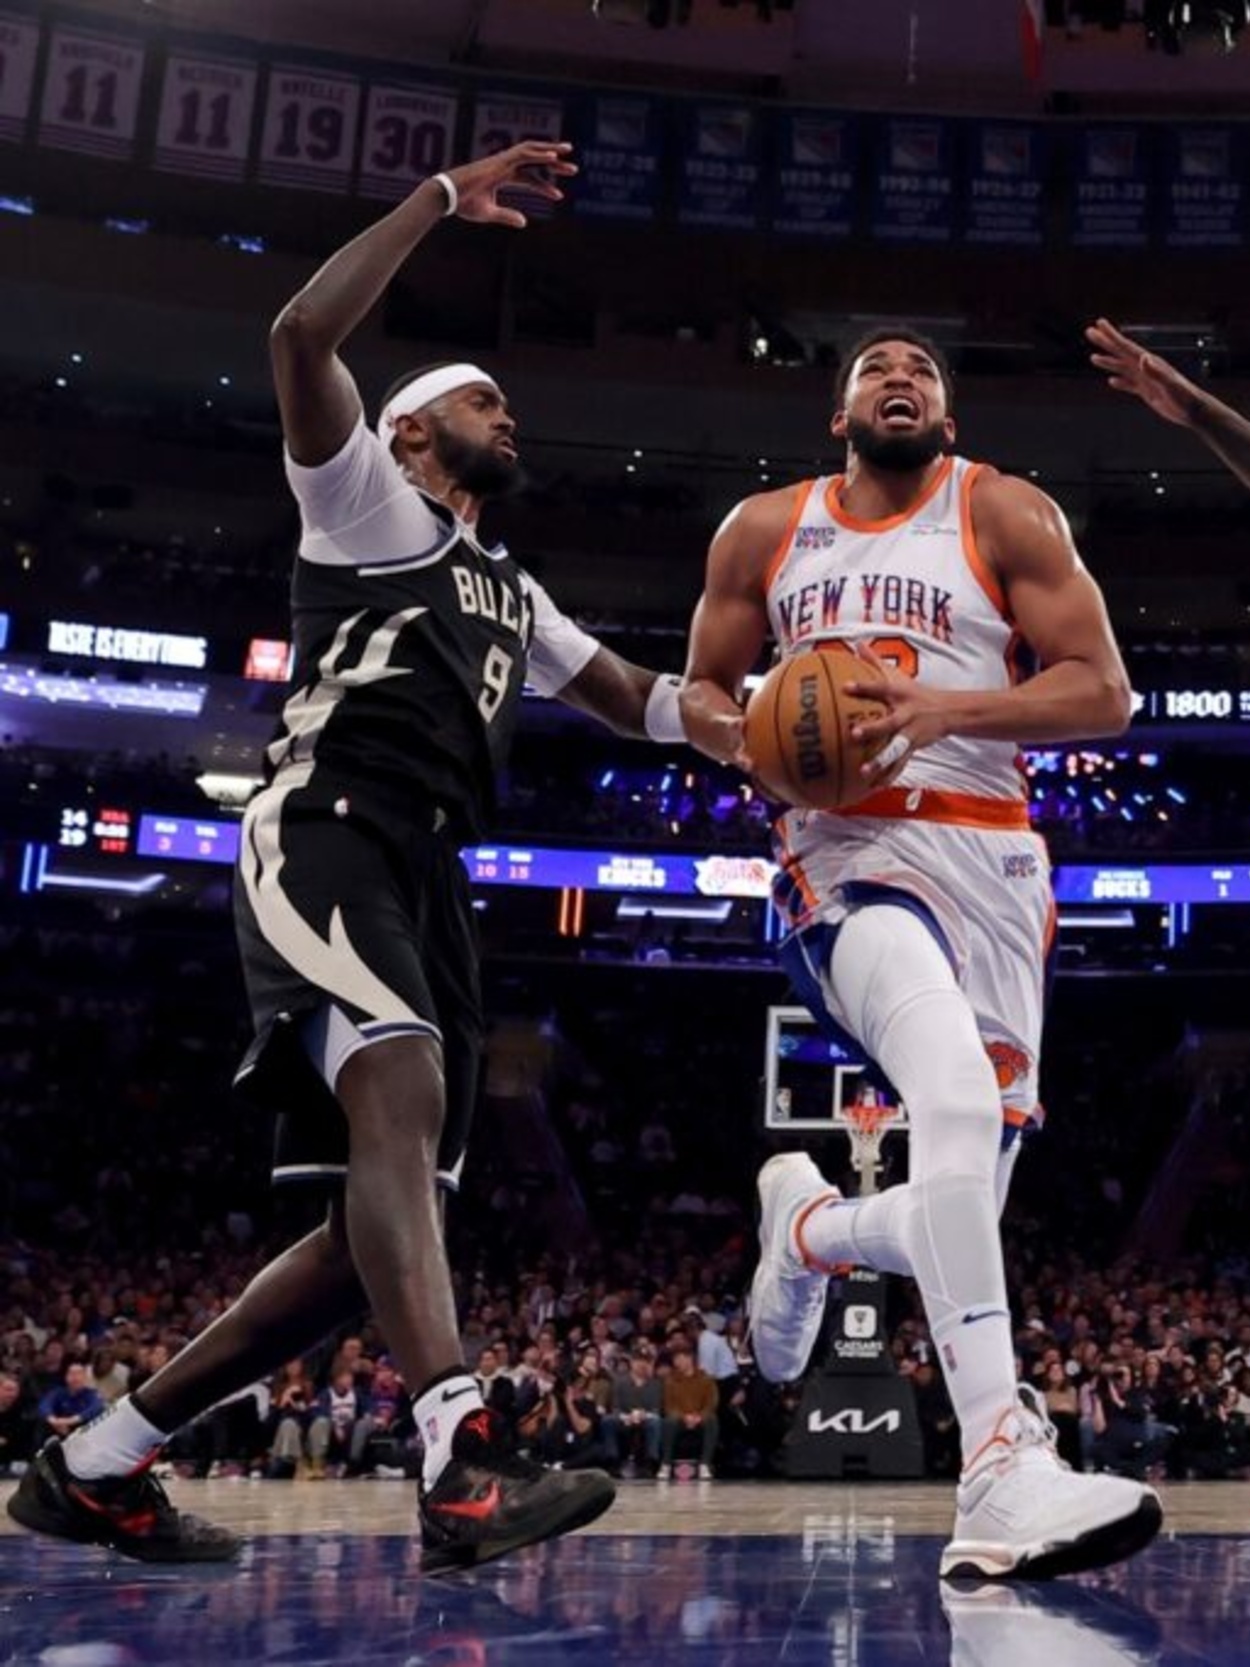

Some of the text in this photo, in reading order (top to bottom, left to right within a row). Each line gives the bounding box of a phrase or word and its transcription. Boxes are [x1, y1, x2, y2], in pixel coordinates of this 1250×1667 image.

[60, 65, 117, 128] 11
[175, 88, 230, 150] 11
[274, 102, 343, 162] 19
[371, 116, 446, 176] 30
[778, 574, 953, 646] NEW YORK
[478, 644, 513, 723] 9
[1165, 691, 1232, 717] 1800
[793, 674, 827, 780] Wilson
[808, 1408, 900, 1433] KIA
